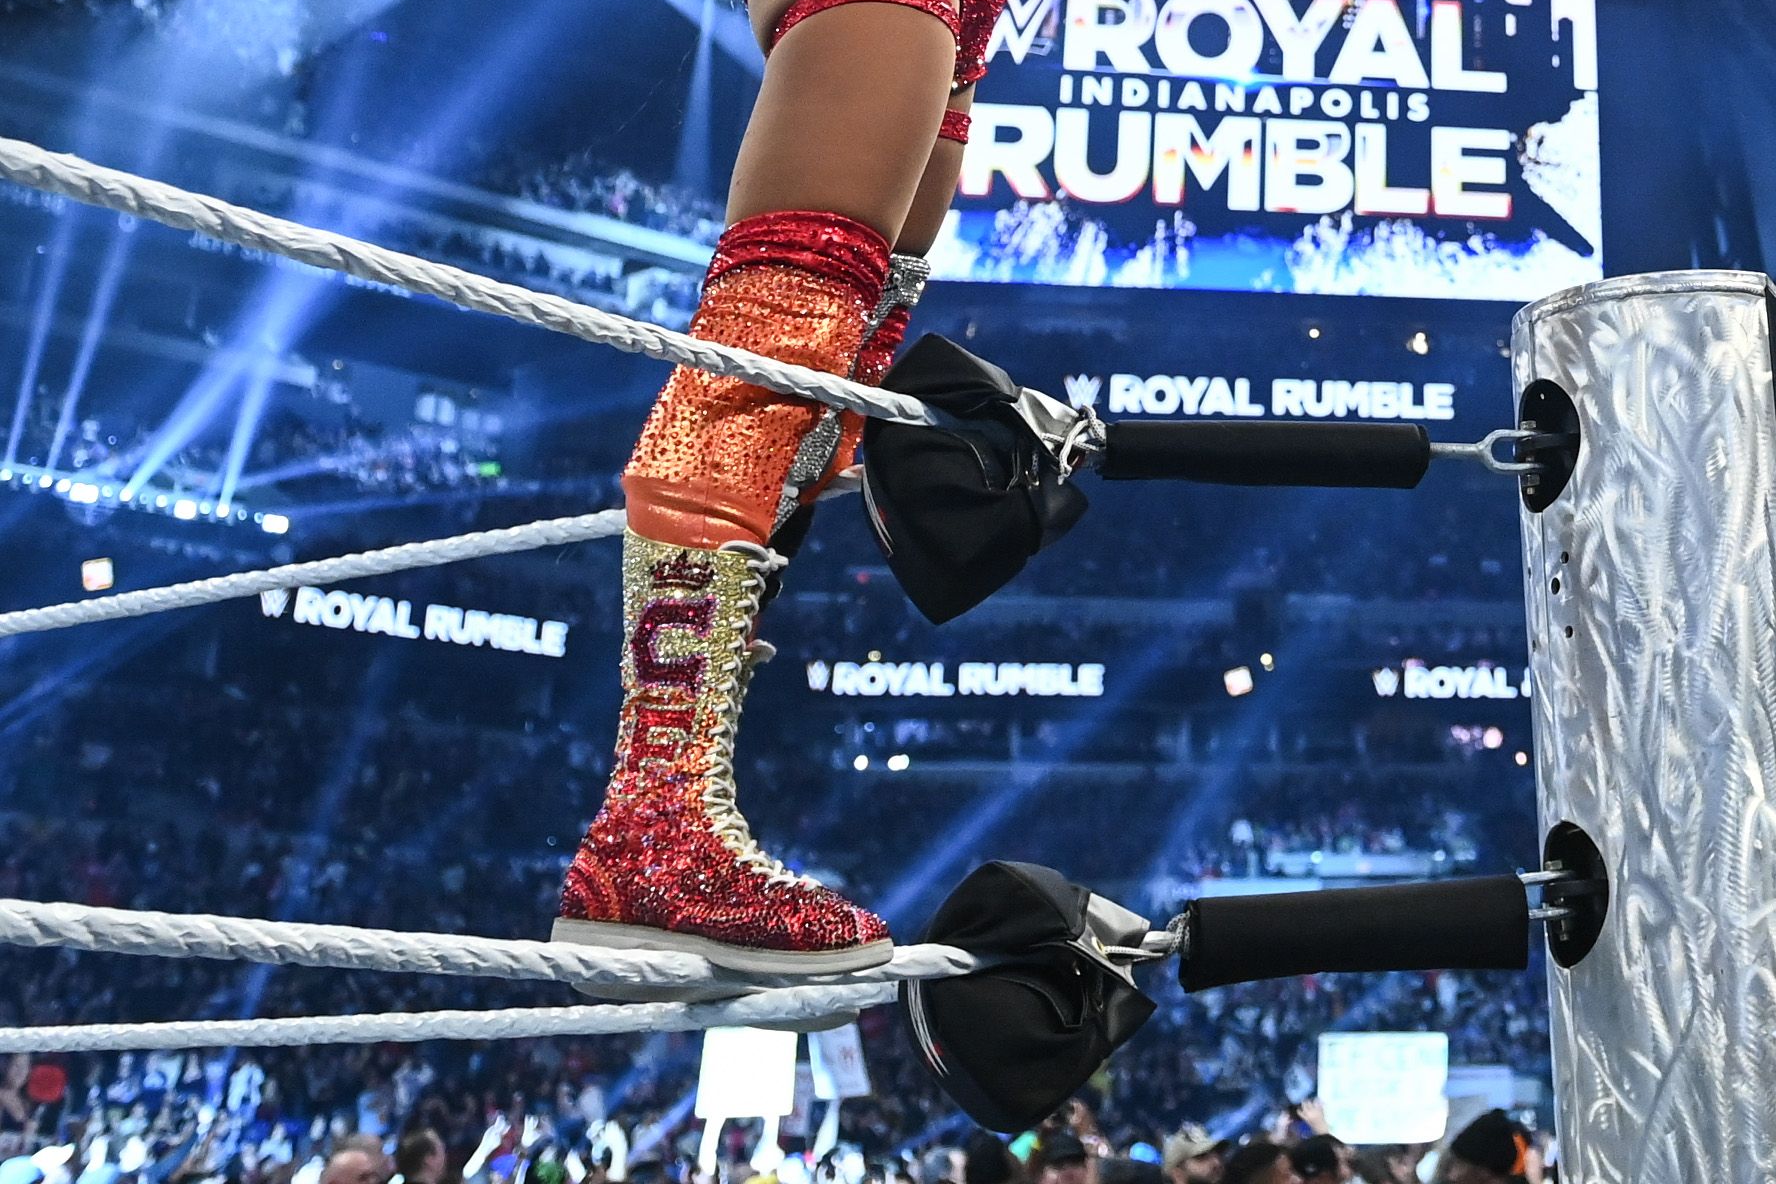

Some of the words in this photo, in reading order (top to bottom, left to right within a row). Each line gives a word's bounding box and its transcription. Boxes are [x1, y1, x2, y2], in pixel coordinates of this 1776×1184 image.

[1059, 74, 1431, 122] INDIANAPOLIS
[957, 102, 1512, 220] RUMBLE
[1109, 373, 1265, 417] ROYAL
[1271, 378, 1455, 420] RUMBLE
[293, 586, 420, 639] ROYAL
[423, 603, 569, 658] RUMBLE
[831, 662, 955, 696] ROYAL
[958, 662, 1105, 696] RUMBLE
[1404, 666, 1518, 699] ROYAL
